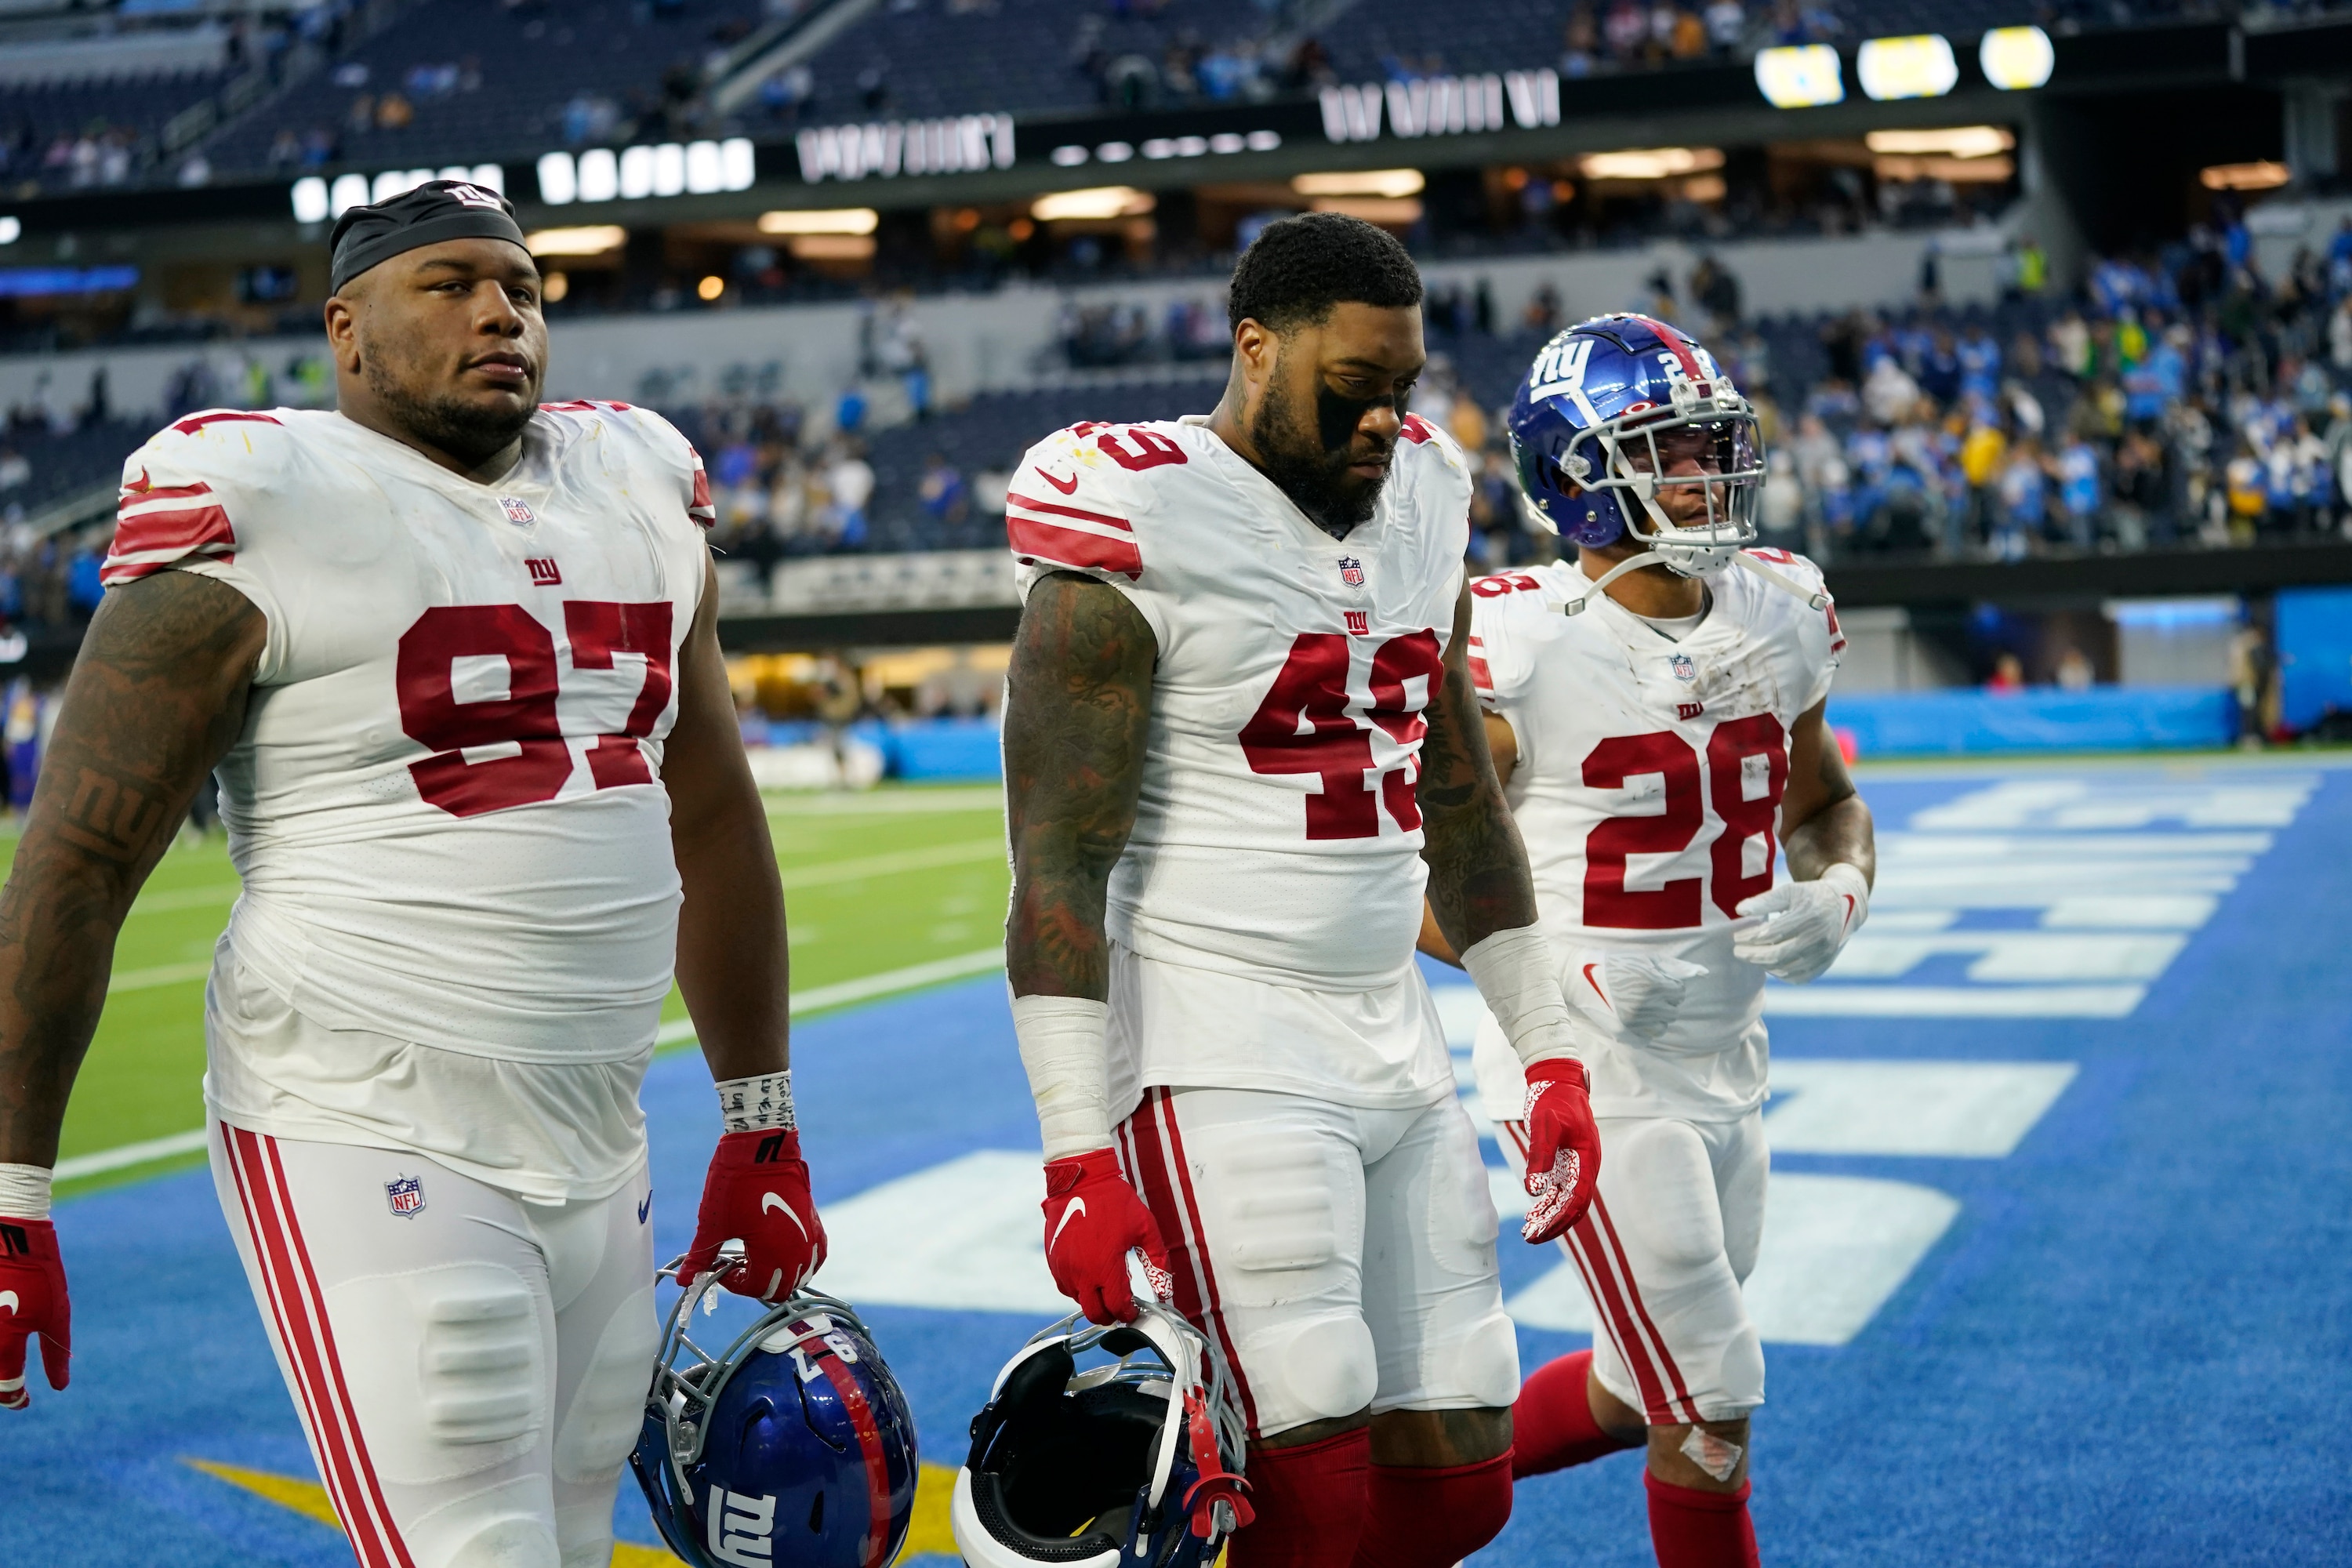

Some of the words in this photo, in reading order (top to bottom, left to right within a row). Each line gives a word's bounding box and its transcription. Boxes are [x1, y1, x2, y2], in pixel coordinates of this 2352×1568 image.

[508, 508, 532, 521] NFL
[1343, 569, 1363, 584] NFL
[1675, 665, 1693, 677] NFL
[396, 600, 673, 820] 97
[1238, 627, 1444, 840] 49
[1581, 712, 1789, 930] 28
[393, 1192, 420, 1210] NFL
